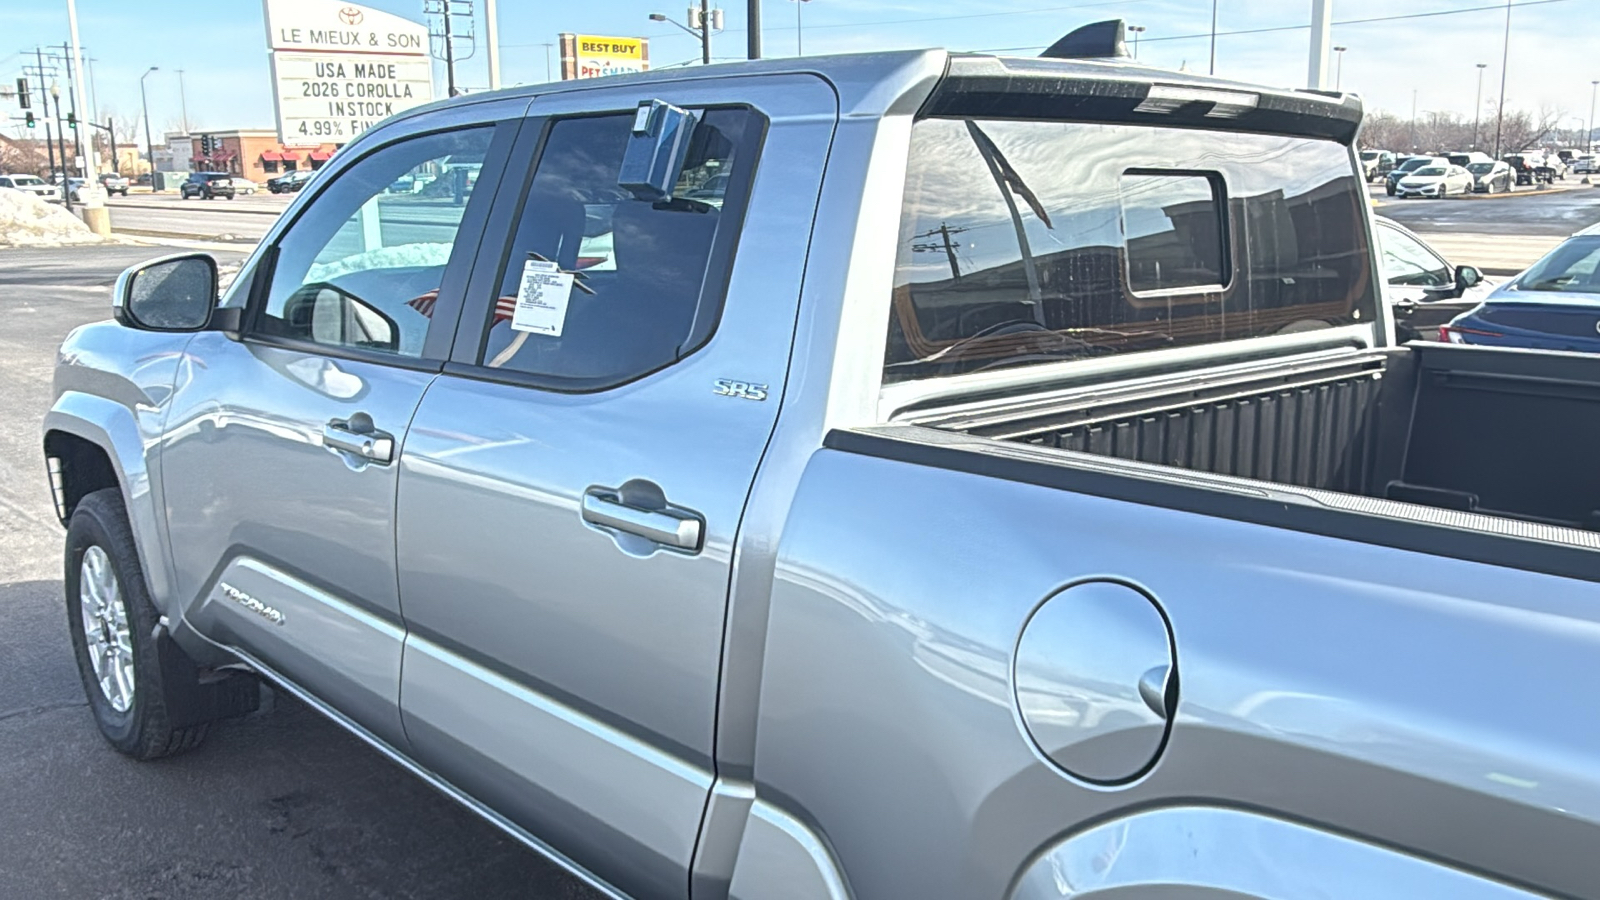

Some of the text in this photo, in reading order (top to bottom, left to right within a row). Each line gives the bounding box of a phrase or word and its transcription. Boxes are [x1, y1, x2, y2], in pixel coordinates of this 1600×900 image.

[281, 28, 421, 48] LE MIEUX & SON
[582, 42, 636, 54] BEST BUY
[316, 62, 396, 79] USA MADE
[302, 82, 413, 99] 2026 COROLLA
[299, 120, 379, 136] 4.99% FIN
[713, 378, 769, 401] SR5
[221, 582, 286, 626] TACOMA
